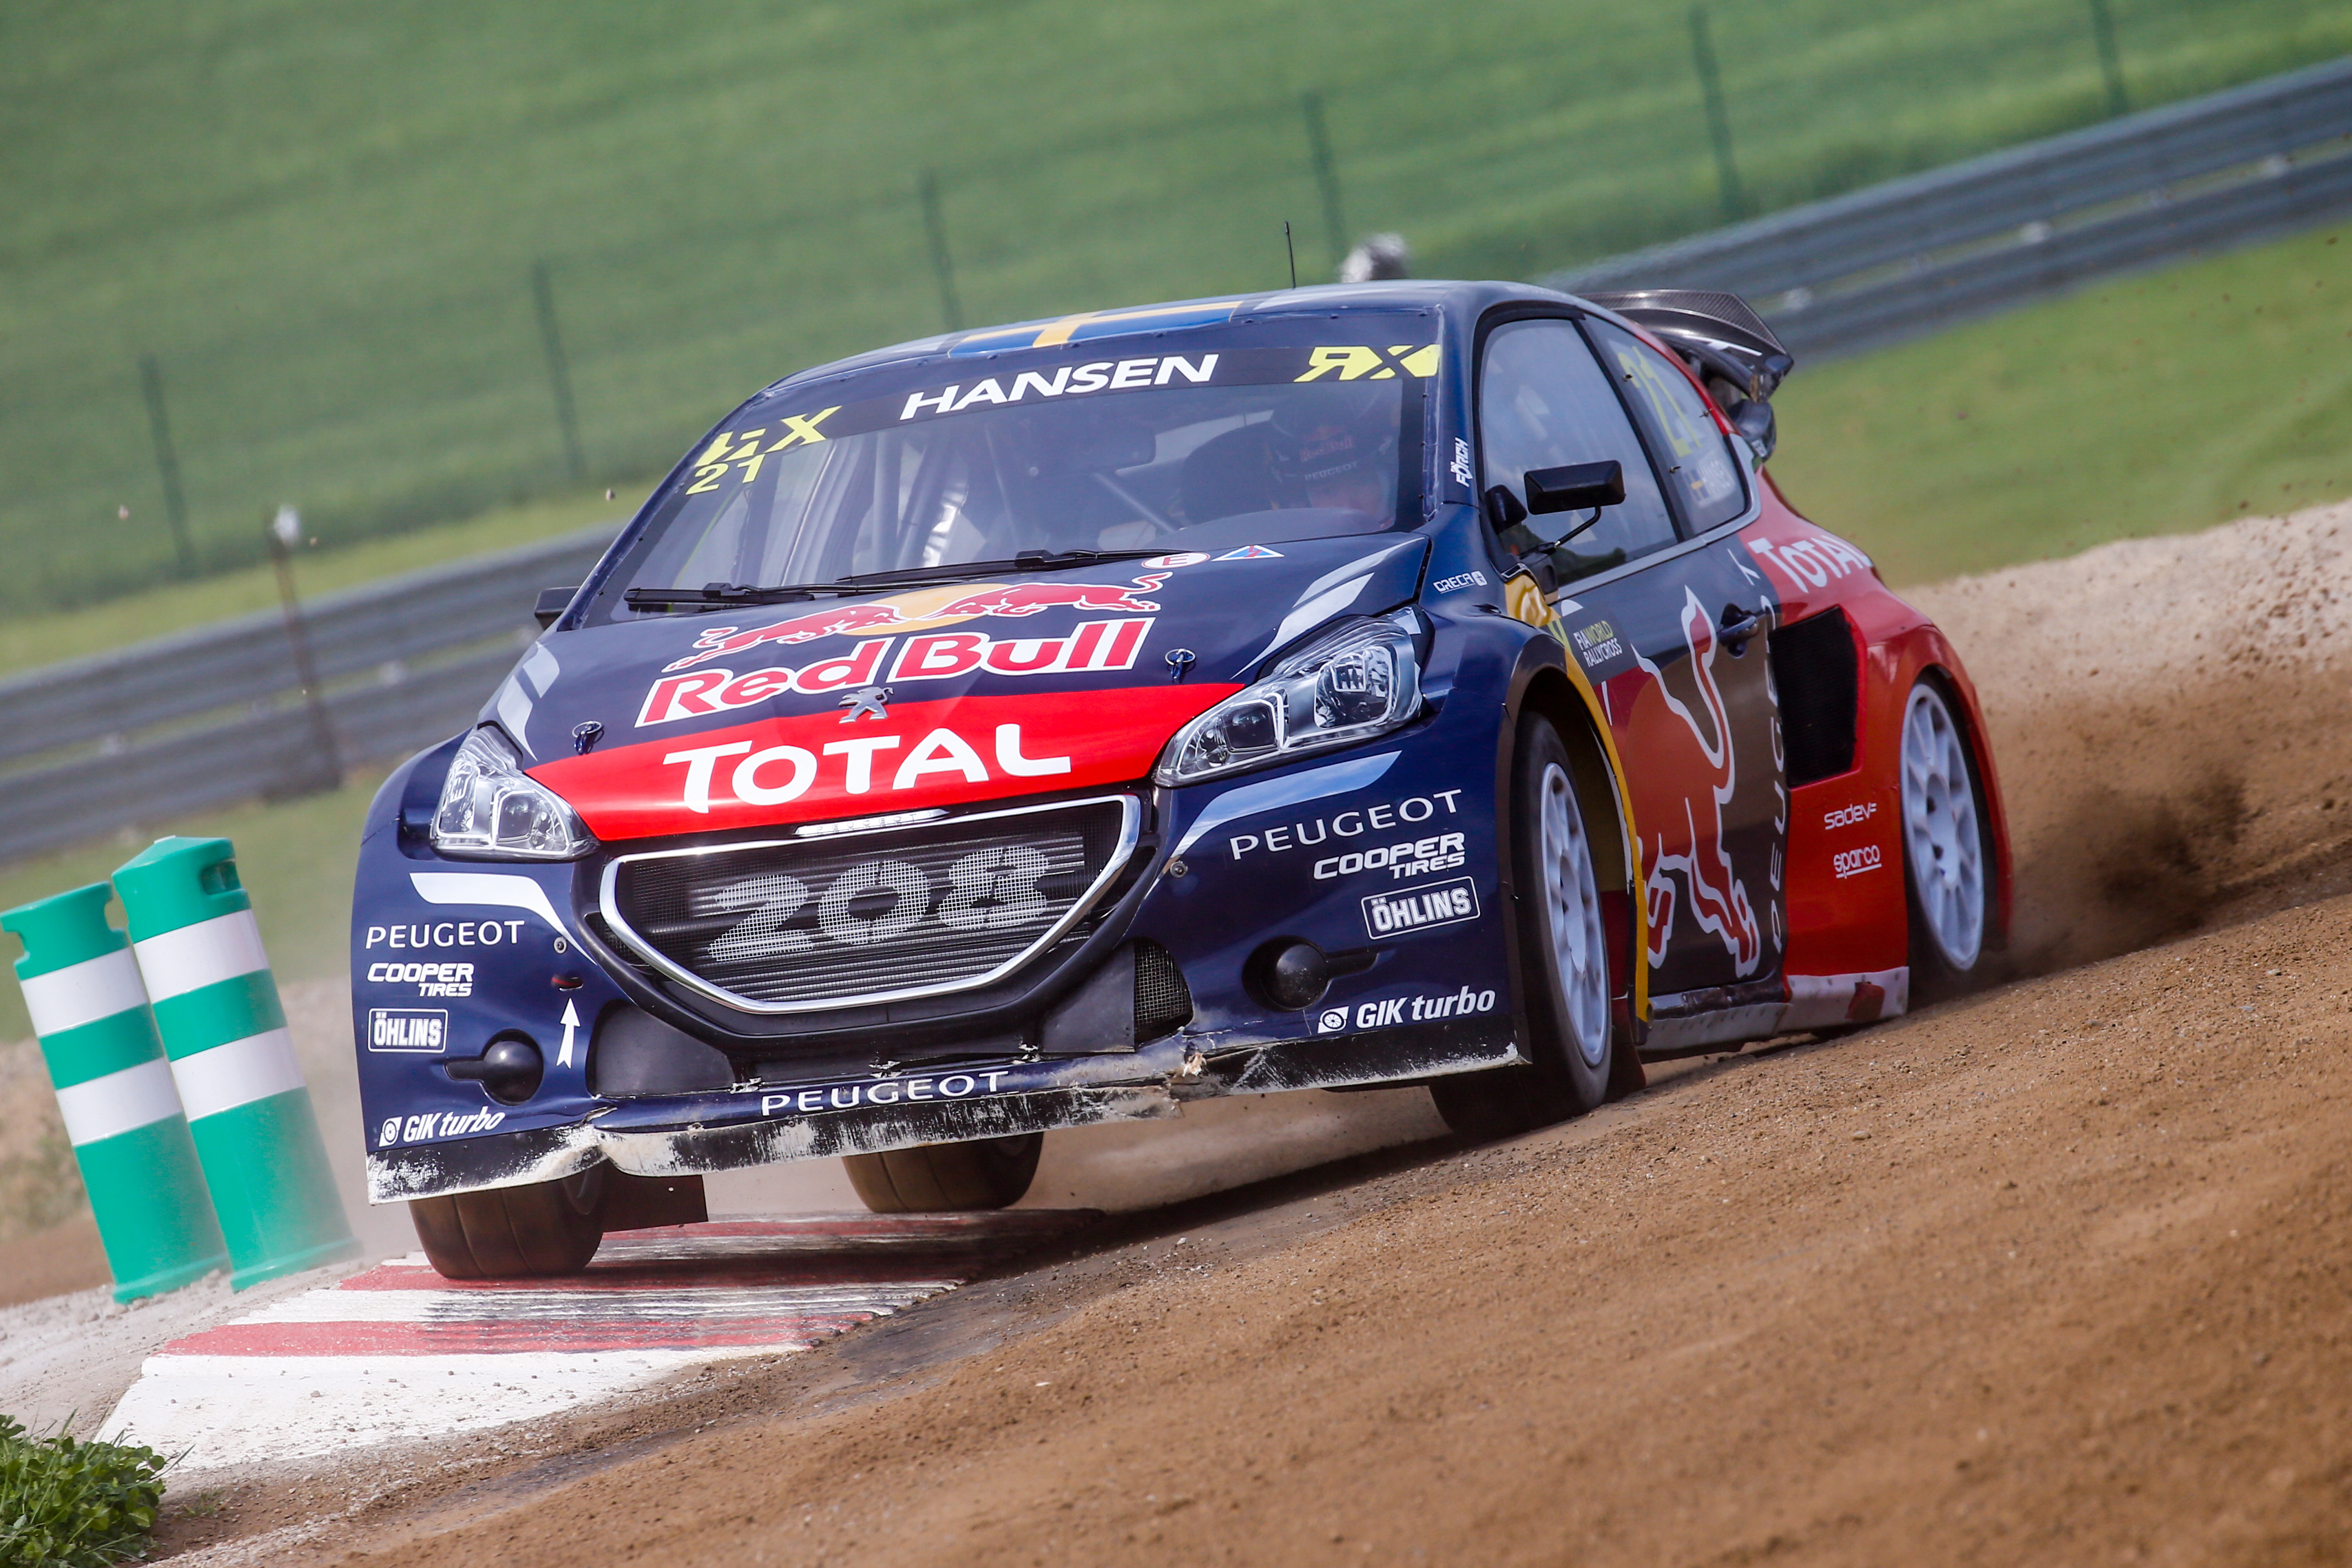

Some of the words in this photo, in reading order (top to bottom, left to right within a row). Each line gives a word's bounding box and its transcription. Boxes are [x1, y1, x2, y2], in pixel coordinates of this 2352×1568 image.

[899, 353, 1219, 420] HANSEN
[1617, 346, 1702, 458] 21
[685, 452, 766, 496] 21
[1304, 461, 1358, 481] PEUGEOT
[1450, 437, 1473, 487] FÖRCH
[1433, 573, 1474, 593] ORECA
[1748, 535, 1874, 593] TOTAL
[634, 636, 896, 728] Red
[886, 617, 1156, 683] Bull
[1583, 638, 1622, 668] RALLYCROSS
[663, 723, 1071, 813] TOTAL
[816, 813, 917, 834] PEUGEOT
[1230, 789, 1462, 860] PEUGEOT
[1314, 832, 1465, 880] COOPER
[1389, 852, 1465, 879] TIRES
[1834, 845, 1881, 879] sparco
[708, 846, 1050, 962] 208
[1371, 887, 1472, 931] ÖHLINS
[366, 920, 525, 949] PEUGEOT
[367, 962, 475, 982] COOPER
[418, 983, 473, 997] TIRES
[1411, 986, 1495, 1021] turbo
[373, 1012, 442, 1046] ÖHLINS
[762, 1071, 1009, 1117] PEUGEOT
[440, 1106, 506, 1137] turbo
